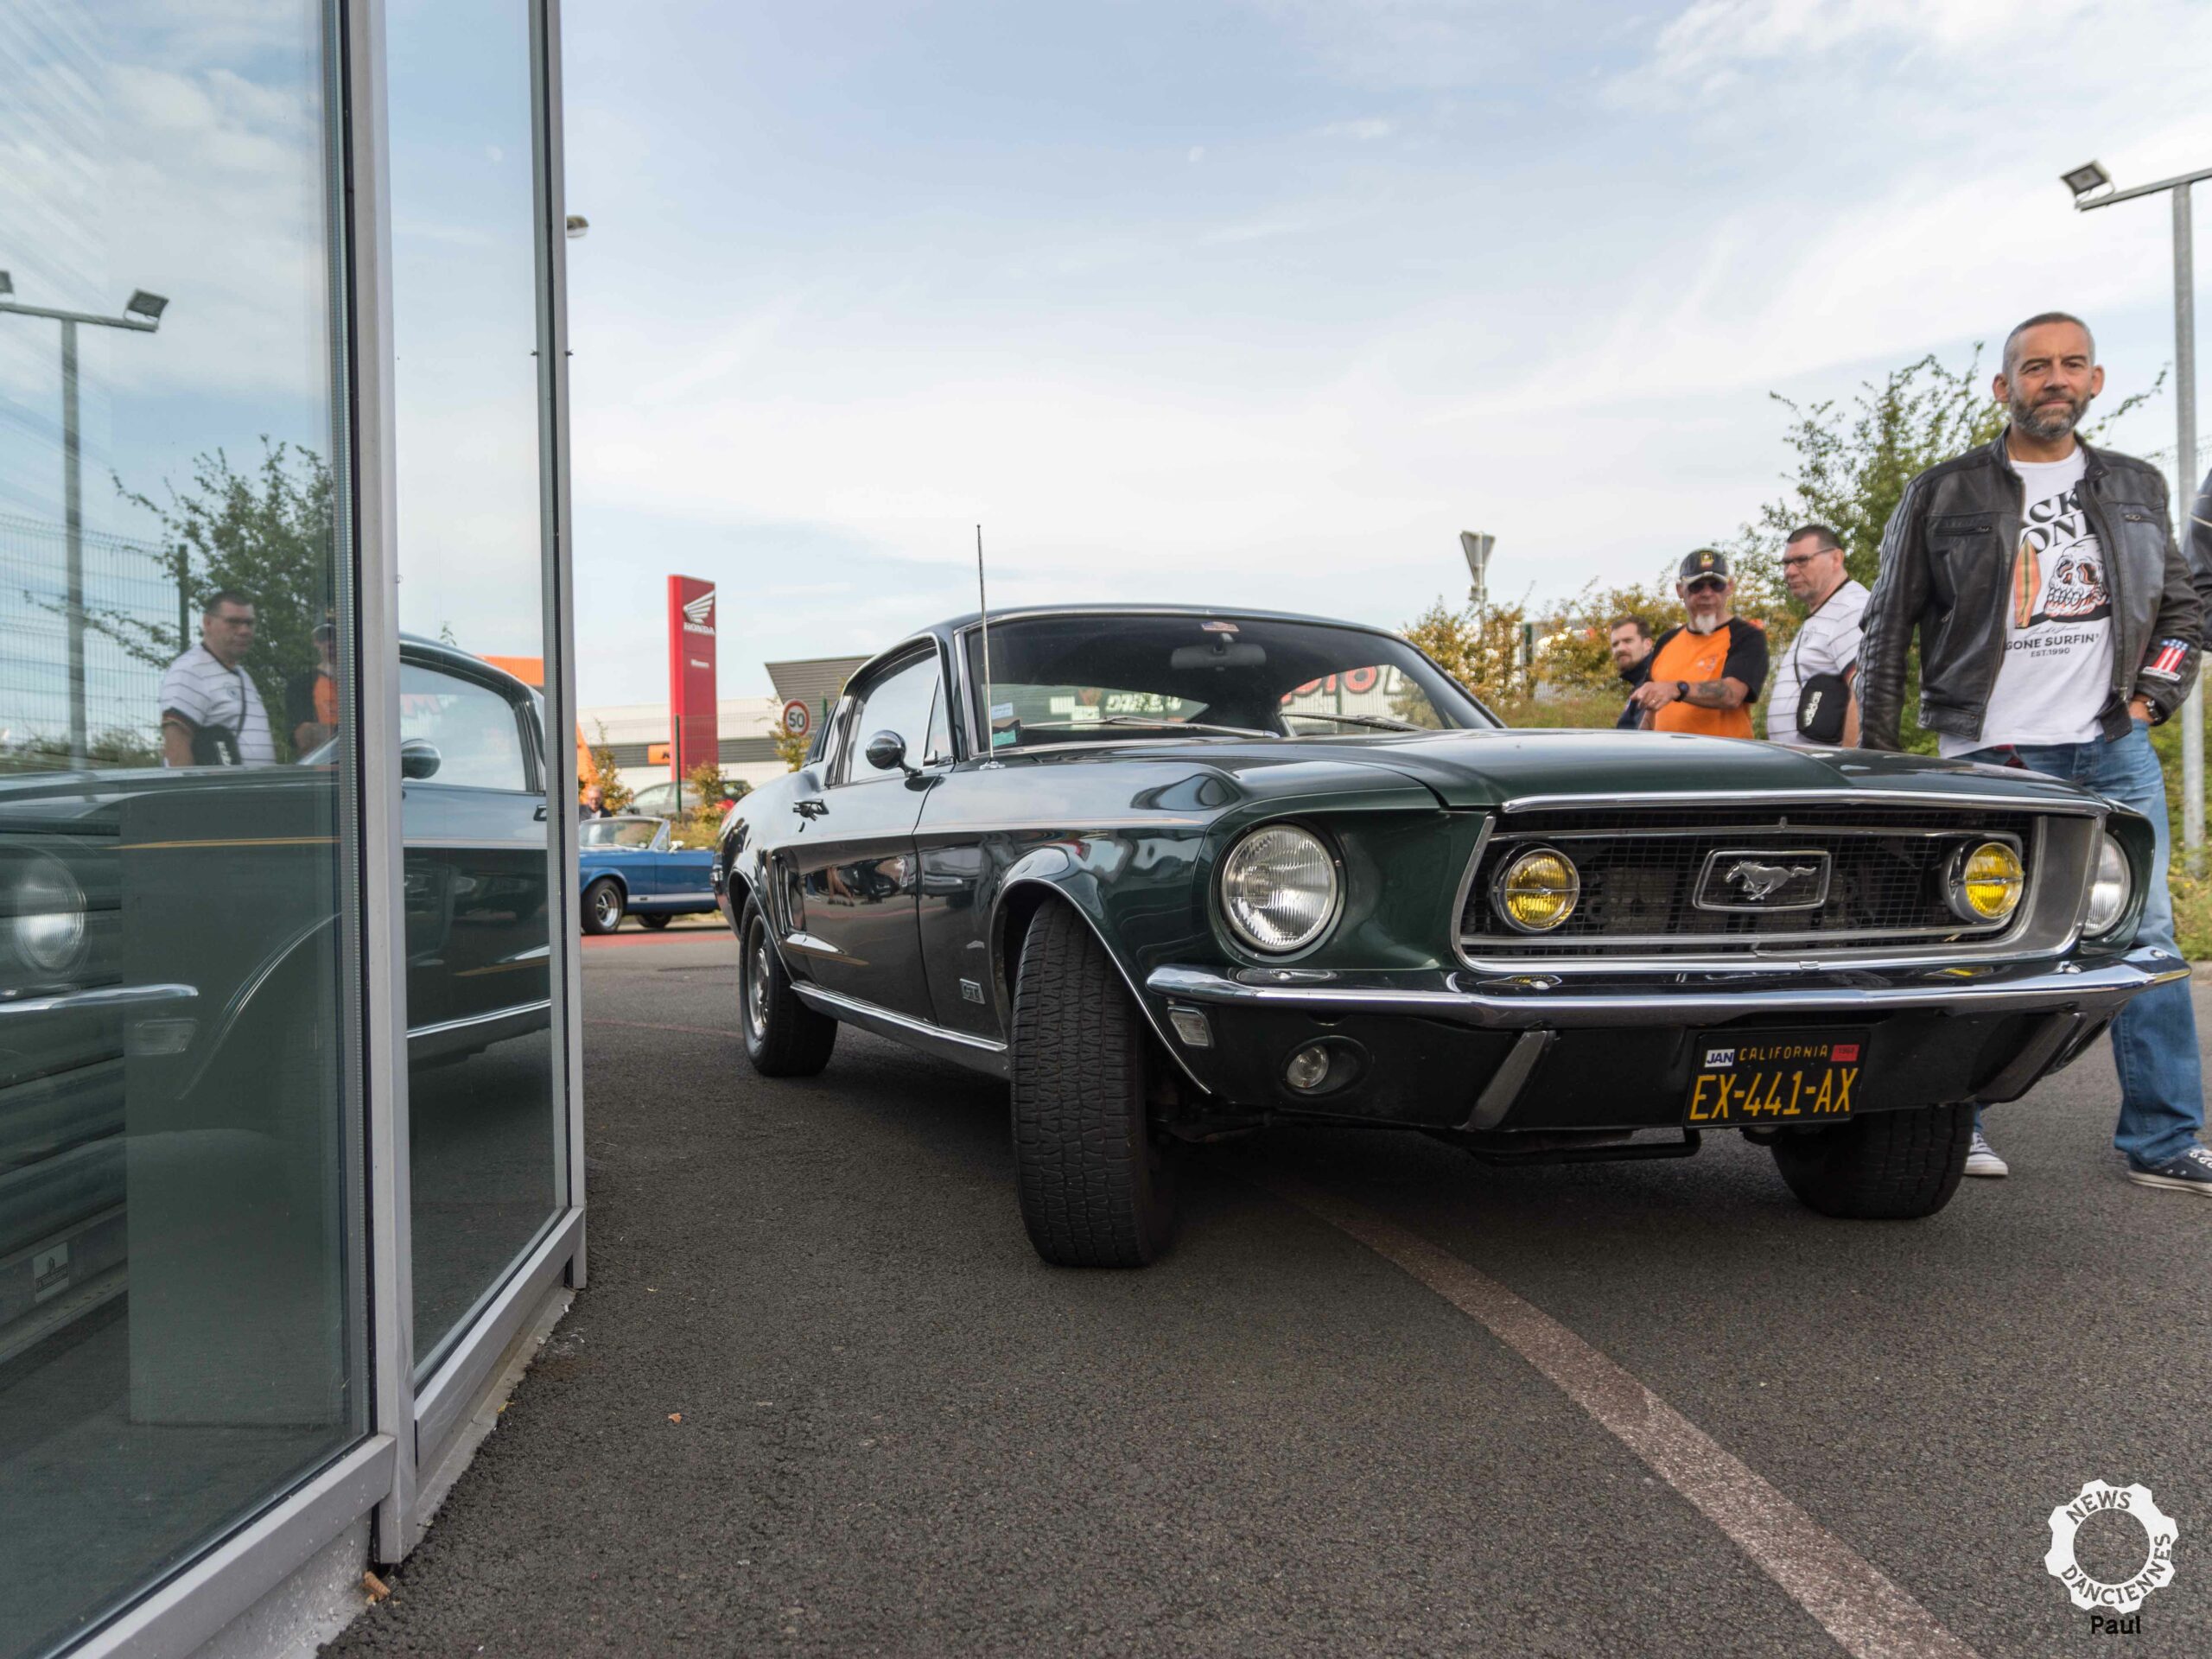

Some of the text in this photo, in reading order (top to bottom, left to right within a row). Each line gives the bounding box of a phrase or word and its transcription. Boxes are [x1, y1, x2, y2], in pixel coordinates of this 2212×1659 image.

[2028, 488, 2082, 524] CK
[683, 621, 715, 636] HONDA
[2005, 638, 2041, 651] GONE
[788, 711, 805, 728] 50
[1707, 1052, 1733, 1065] JAN
[1738, 1044, 1828, 1062] CALIFORNIA
[1689, 1067, 1859, 1121] EX-441-AX
